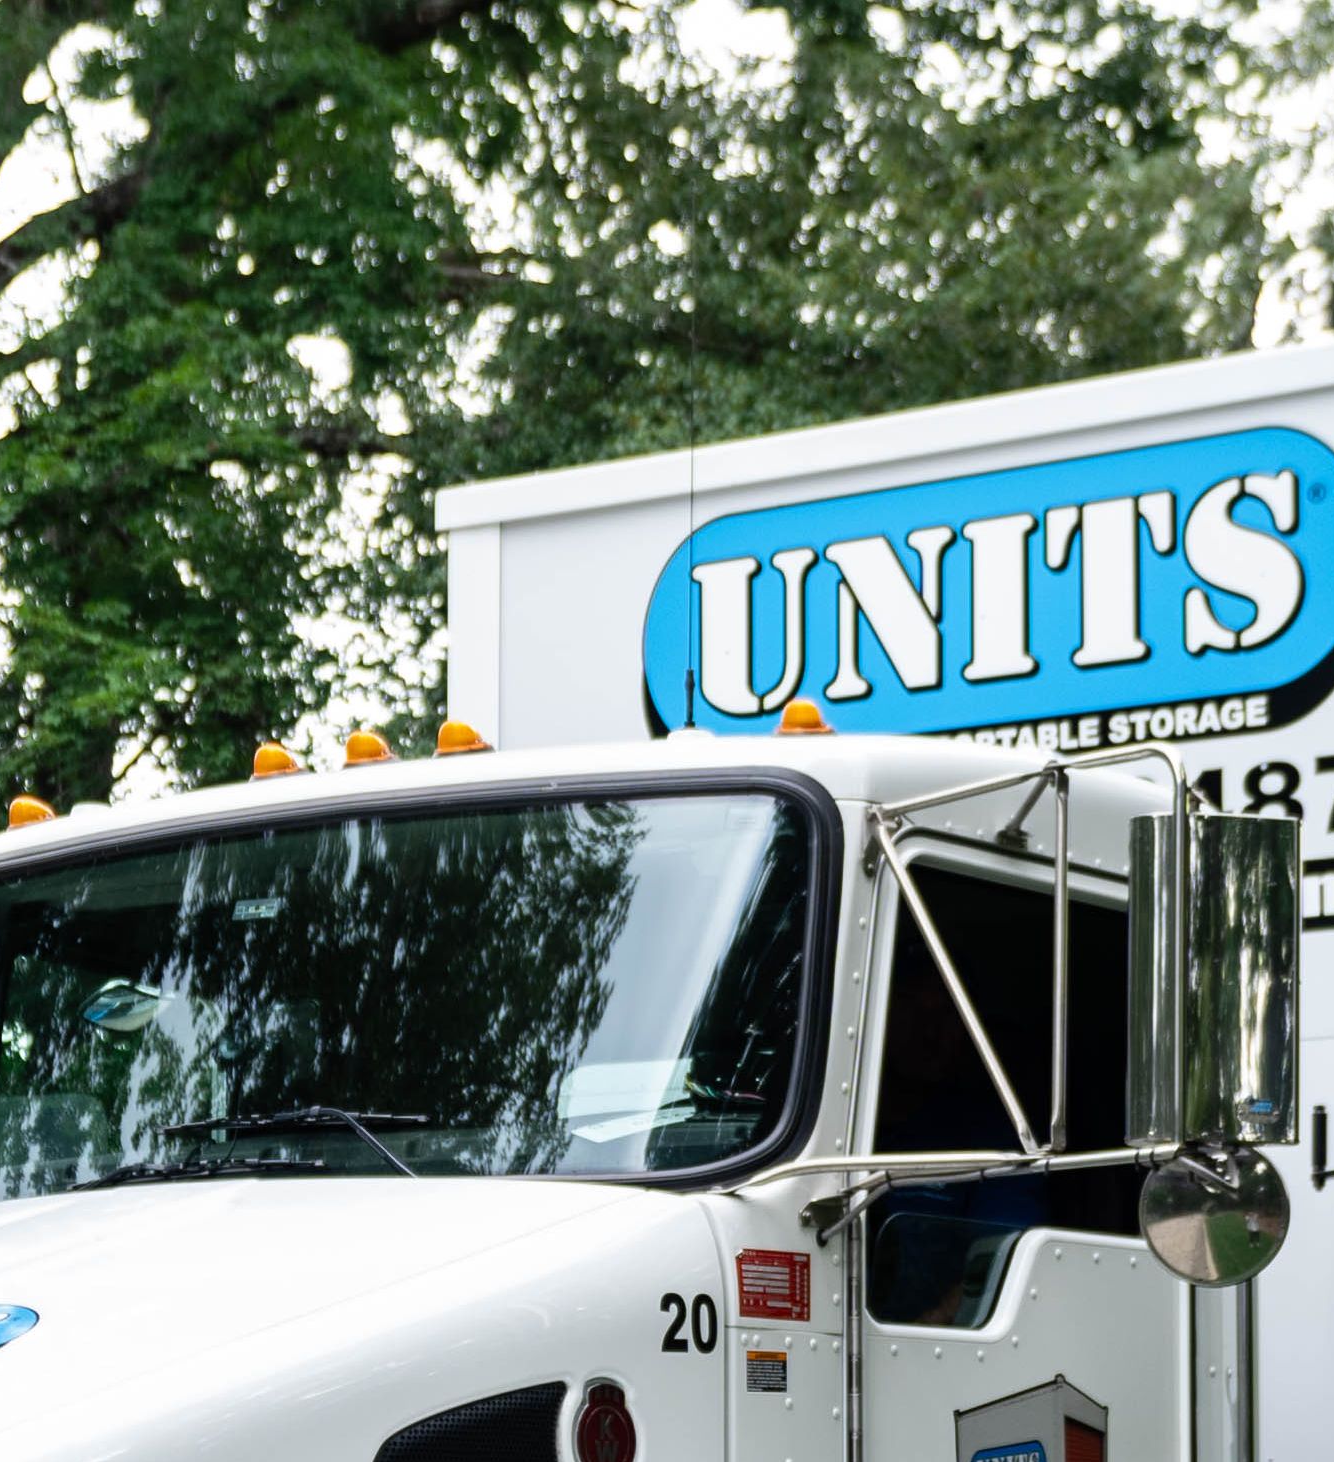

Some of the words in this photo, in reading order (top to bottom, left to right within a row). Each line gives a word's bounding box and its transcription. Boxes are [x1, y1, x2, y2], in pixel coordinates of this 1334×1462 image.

[691, 468, 1305, 716] UNITS
[1107, 696, 1269, 745] STORAGE
[659, 1293, 718, 1354] 20
